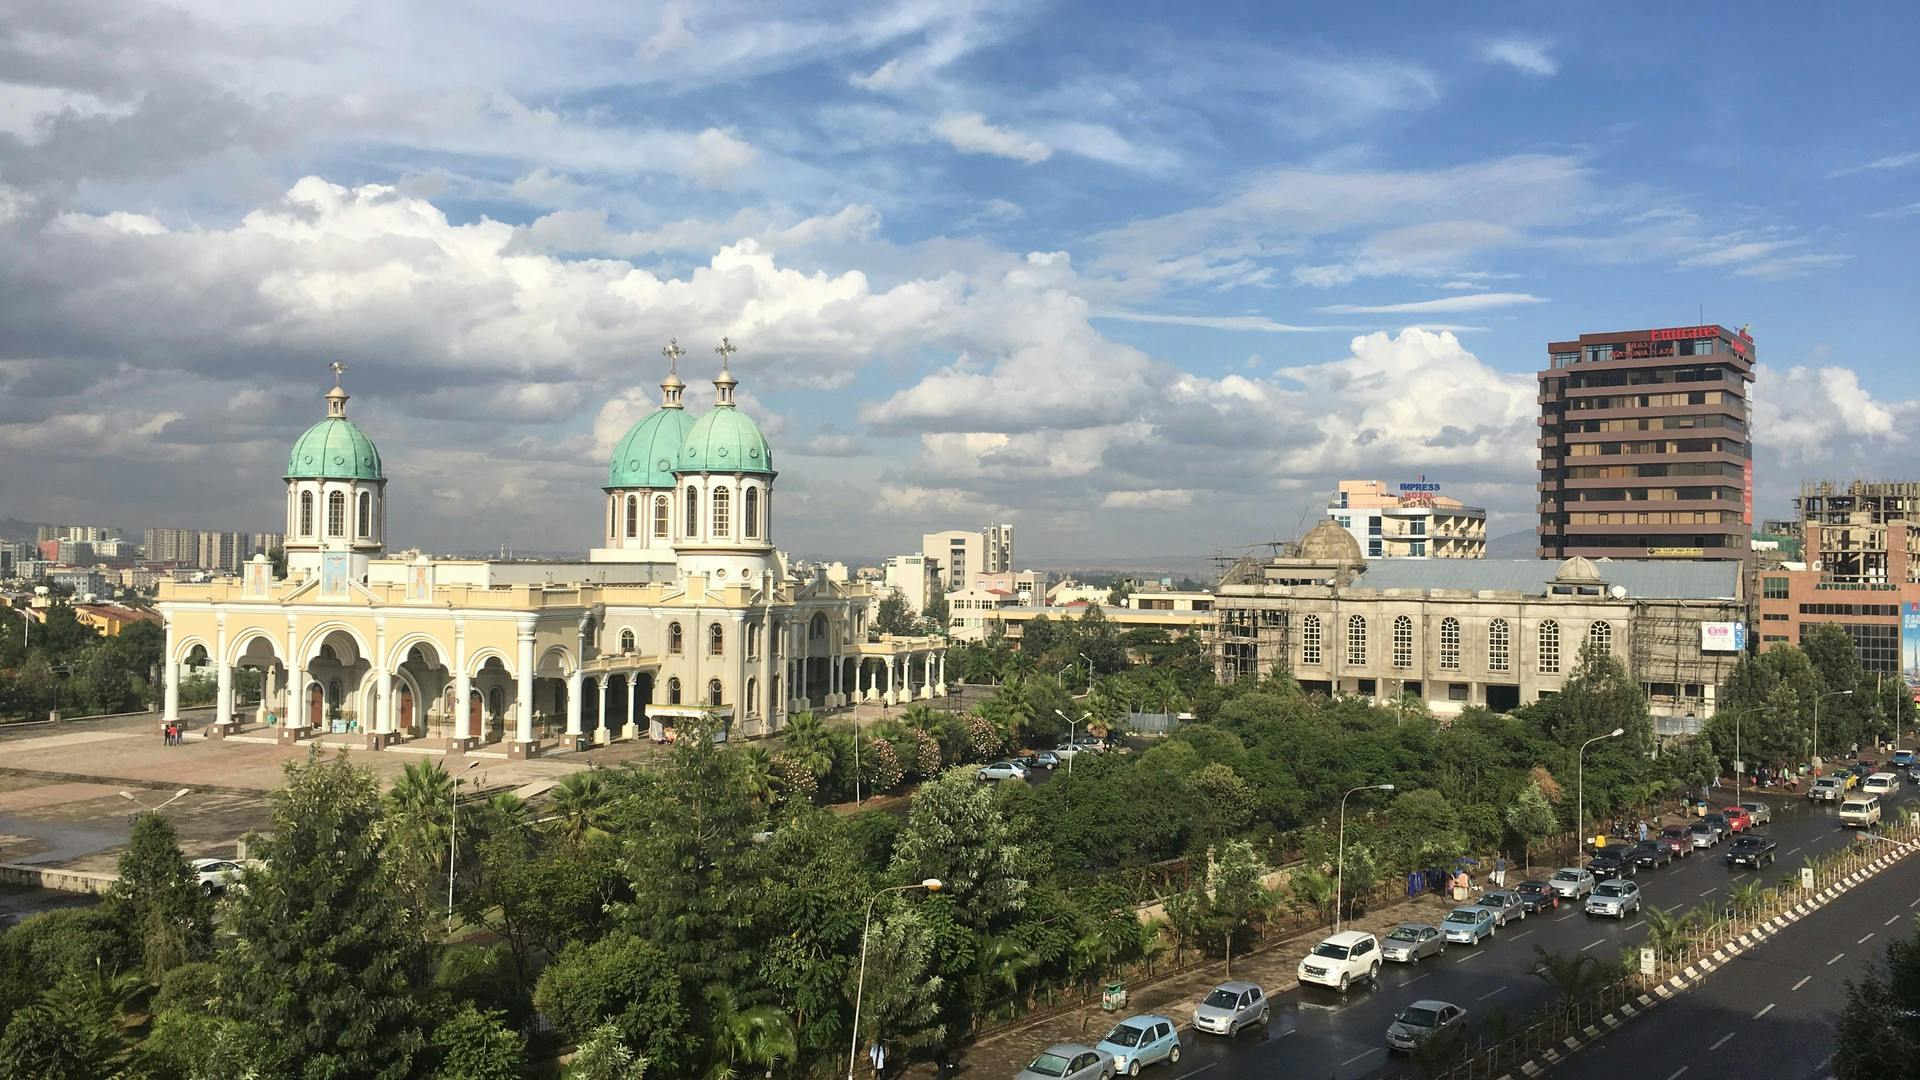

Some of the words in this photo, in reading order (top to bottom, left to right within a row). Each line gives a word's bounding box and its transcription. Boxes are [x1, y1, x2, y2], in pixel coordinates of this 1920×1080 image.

[1650, 326, 1720, 341] Emirates
[1400, 483, 1440, 491] IMPRESS
[1404, 492, 1435, 500] HOTEL
